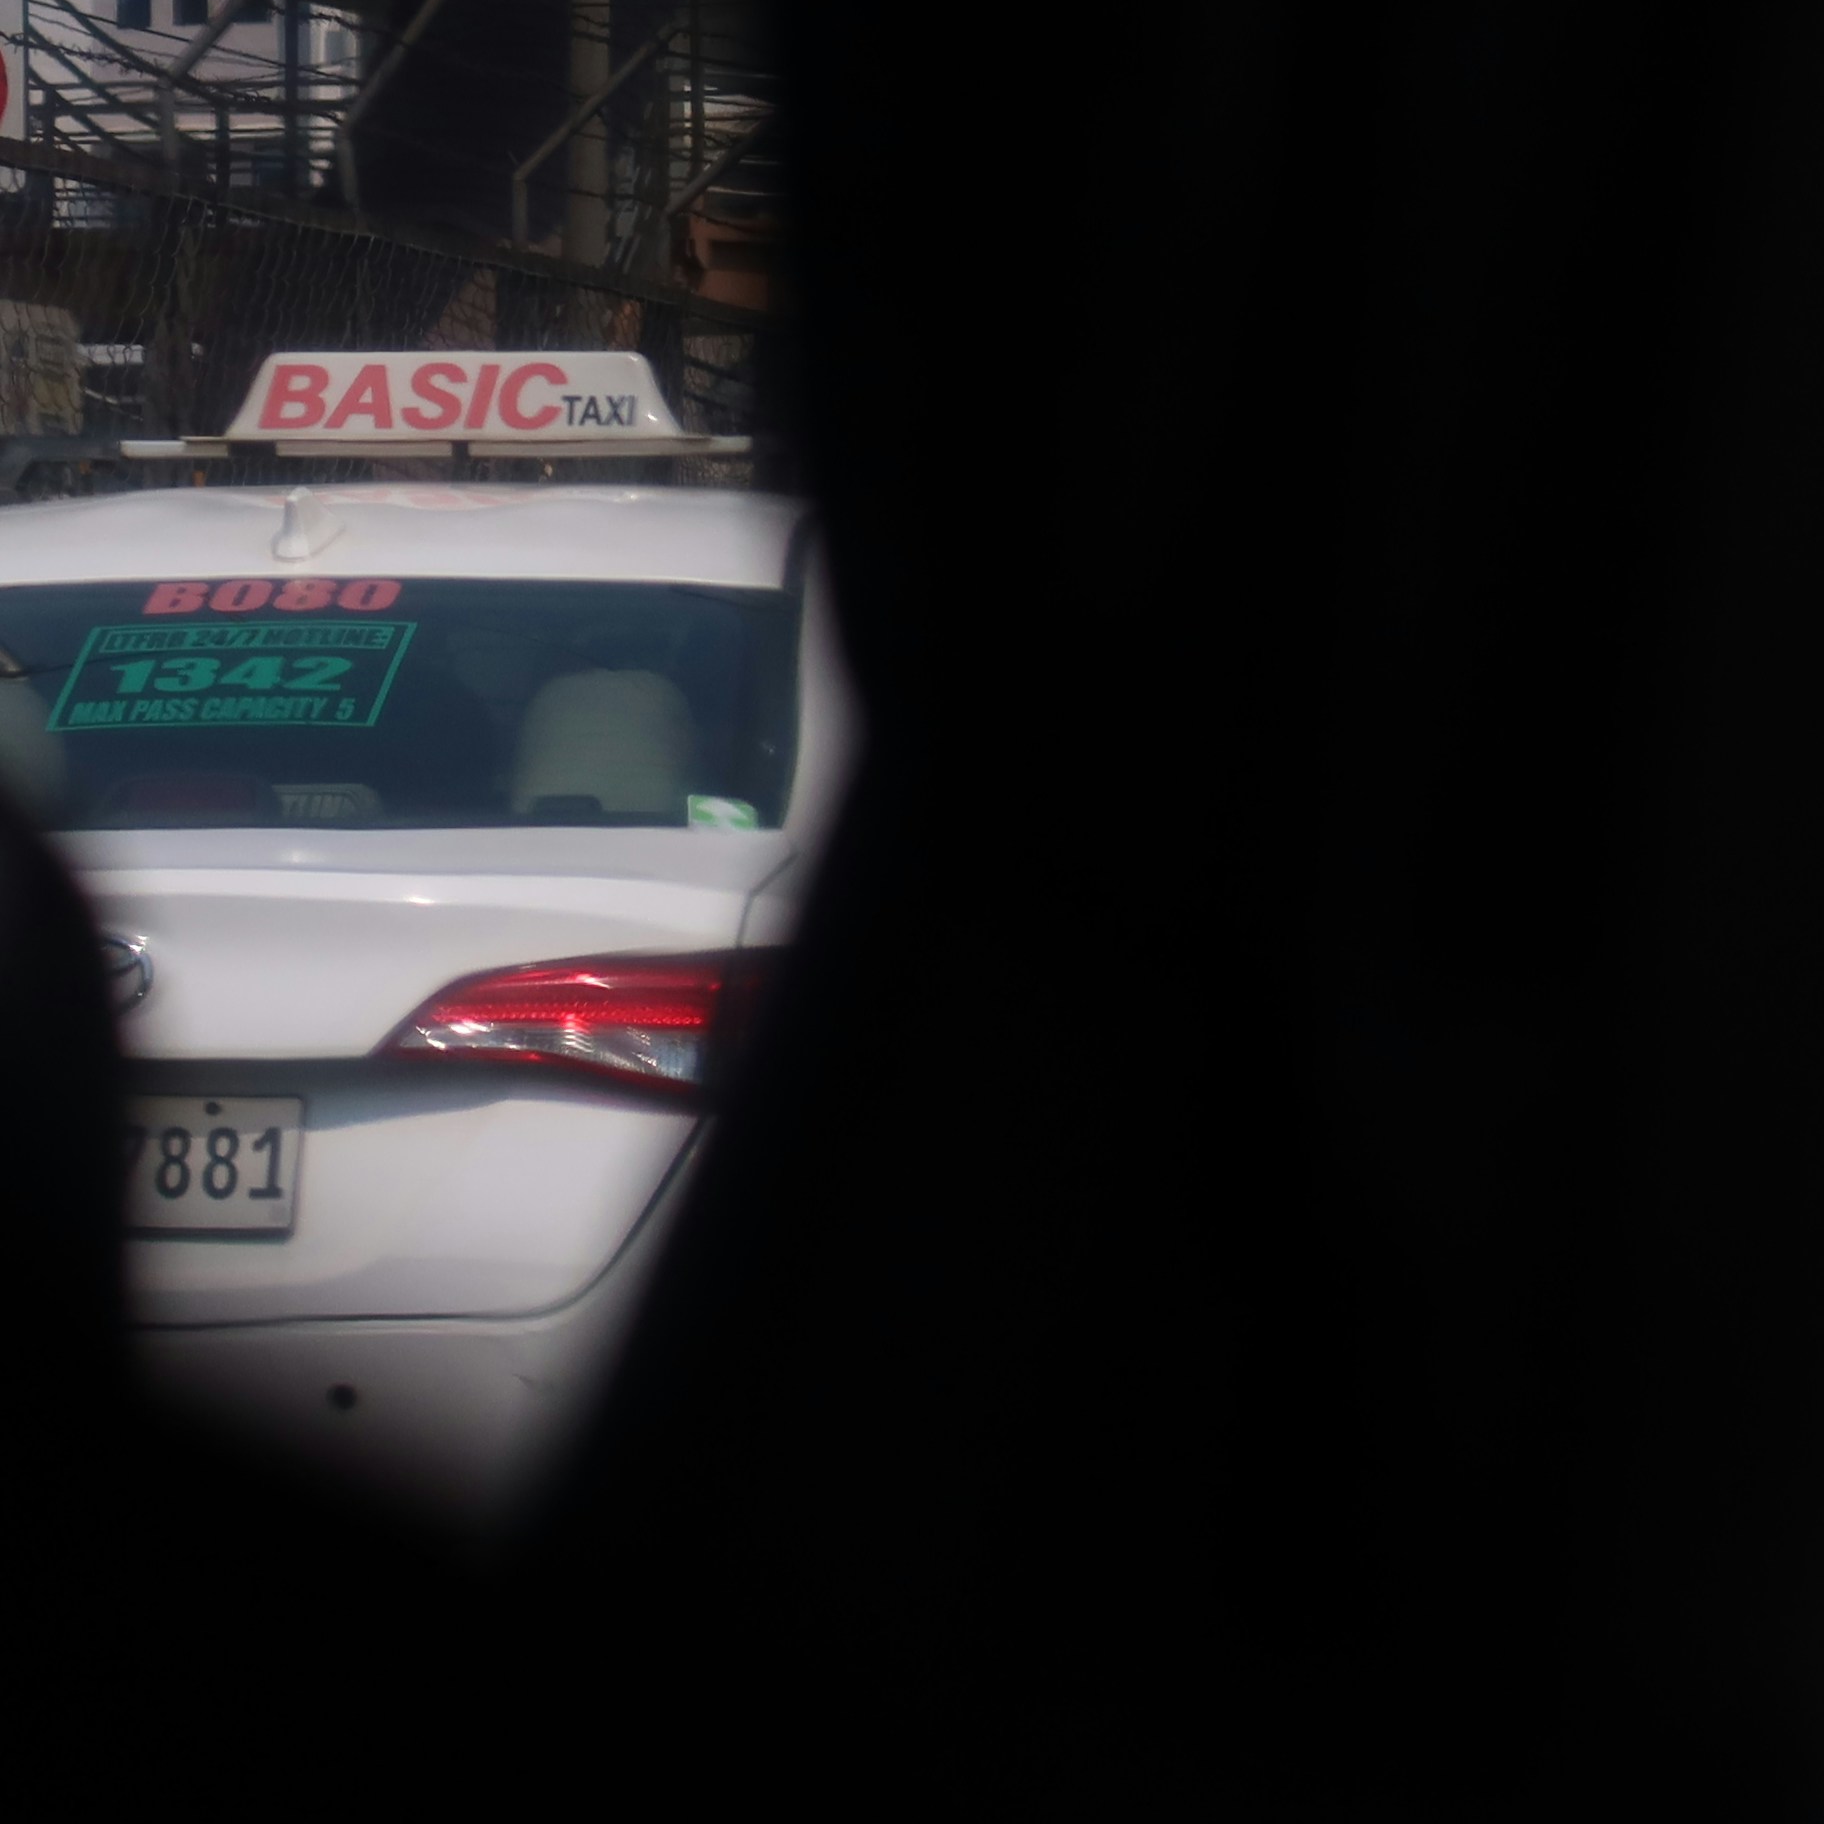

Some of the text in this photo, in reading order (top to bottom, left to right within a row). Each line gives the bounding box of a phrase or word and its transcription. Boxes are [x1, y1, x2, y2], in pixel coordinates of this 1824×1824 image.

[258, 362, 640, 430] BASIC TAXI
[111, 655, 352, 694] 1342
[68, 697, 357, 725] MAX PASS CAPACITY 5
